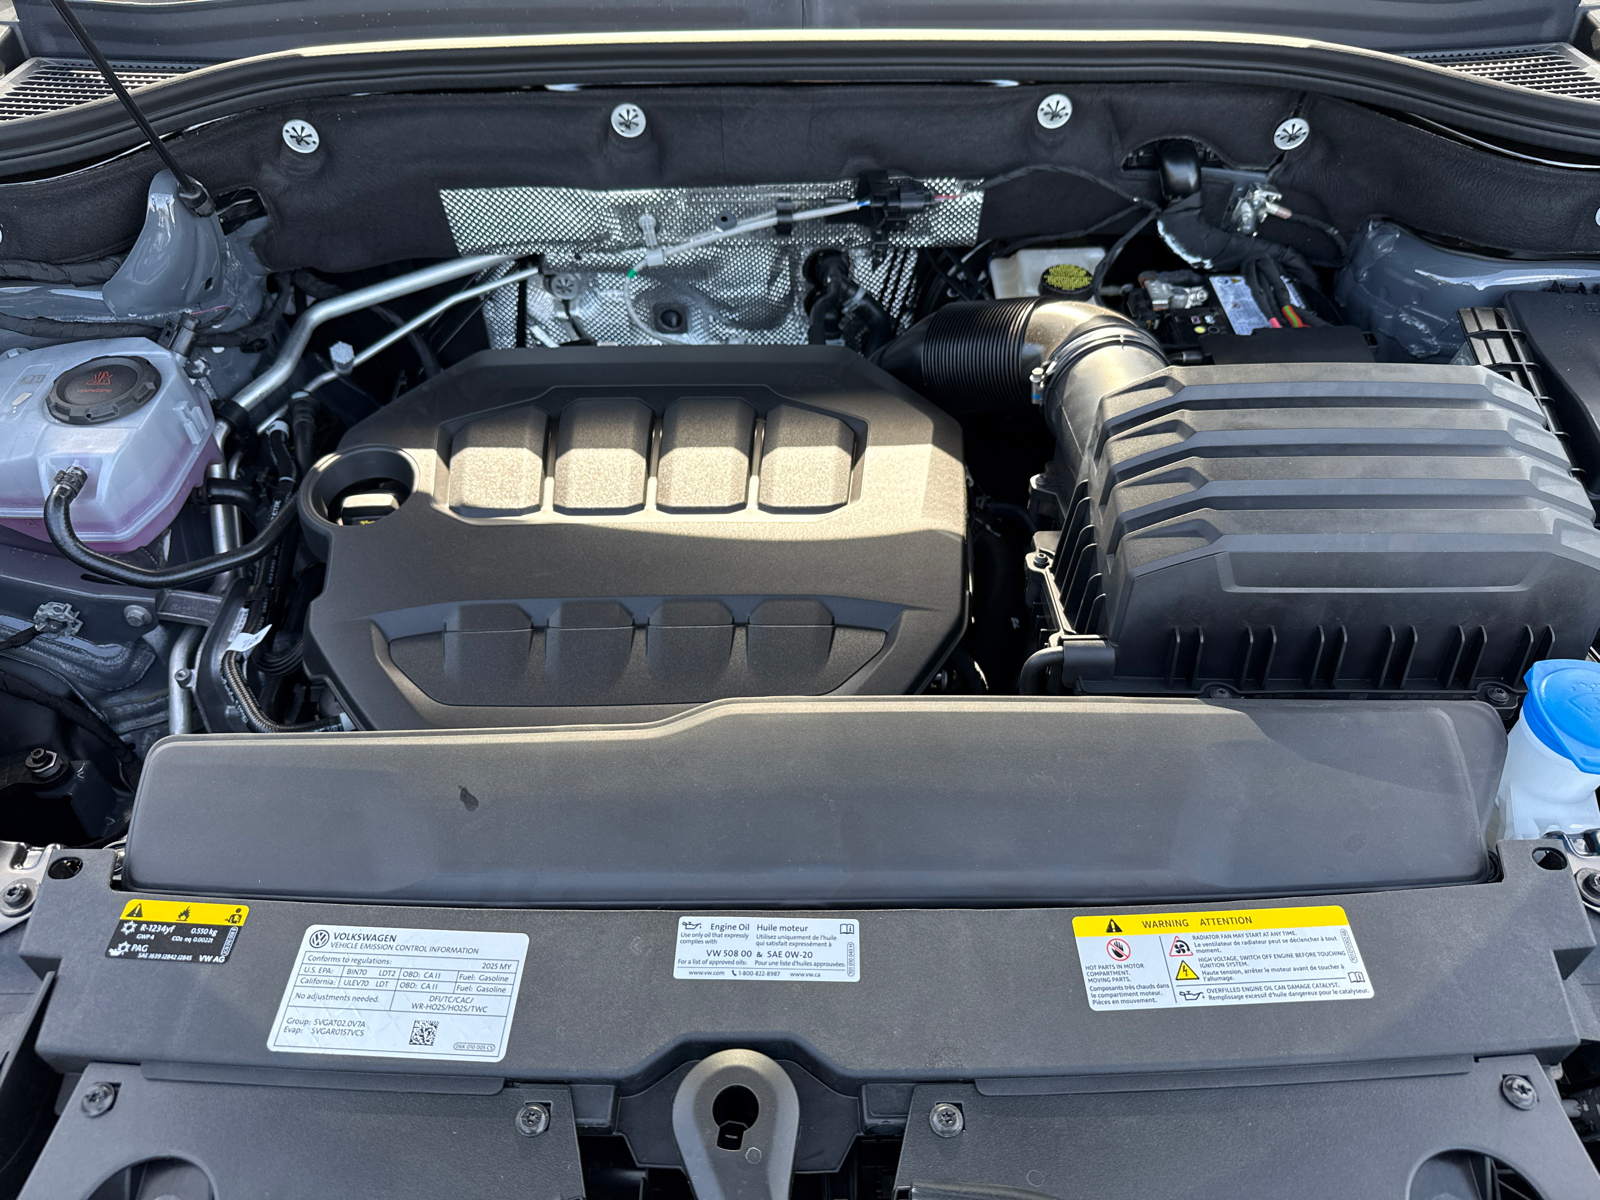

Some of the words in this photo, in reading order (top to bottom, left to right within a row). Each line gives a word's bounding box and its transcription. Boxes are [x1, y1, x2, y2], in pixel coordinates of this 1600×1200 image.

[1142, 919, 1189, 929] WARNING
[1200, 916, 1253, 926] ATTENTION
[140, 924, 176, 934] R-1234yf
[710, 923, 737, 932] Engine
[208, 928, 218, 938] kg
[334, 932, 397, 942] VOLKSWAGEN
[130, 944, 149, 952] PAG
[360, 943, 393, 951] EMISSION
[429, 946, 480, 954] INFORMATION
[307, 955, 340, 963] Conforms
[351, 957, 392, 966] regulations:
[300, 977, 336, 985] California:
[478, 974, 509, 982] Gasoline
[306, 993, 351, 1002] adjustments
[429, 995, 474, 1004] DFI/TC/CAC/
[411, 1003, 488, 1013] WR-HO2S/HO2S/TWC
[286, 1018, 312, 1026] Group:
[284, 1026, 303, 1034] Evap:
